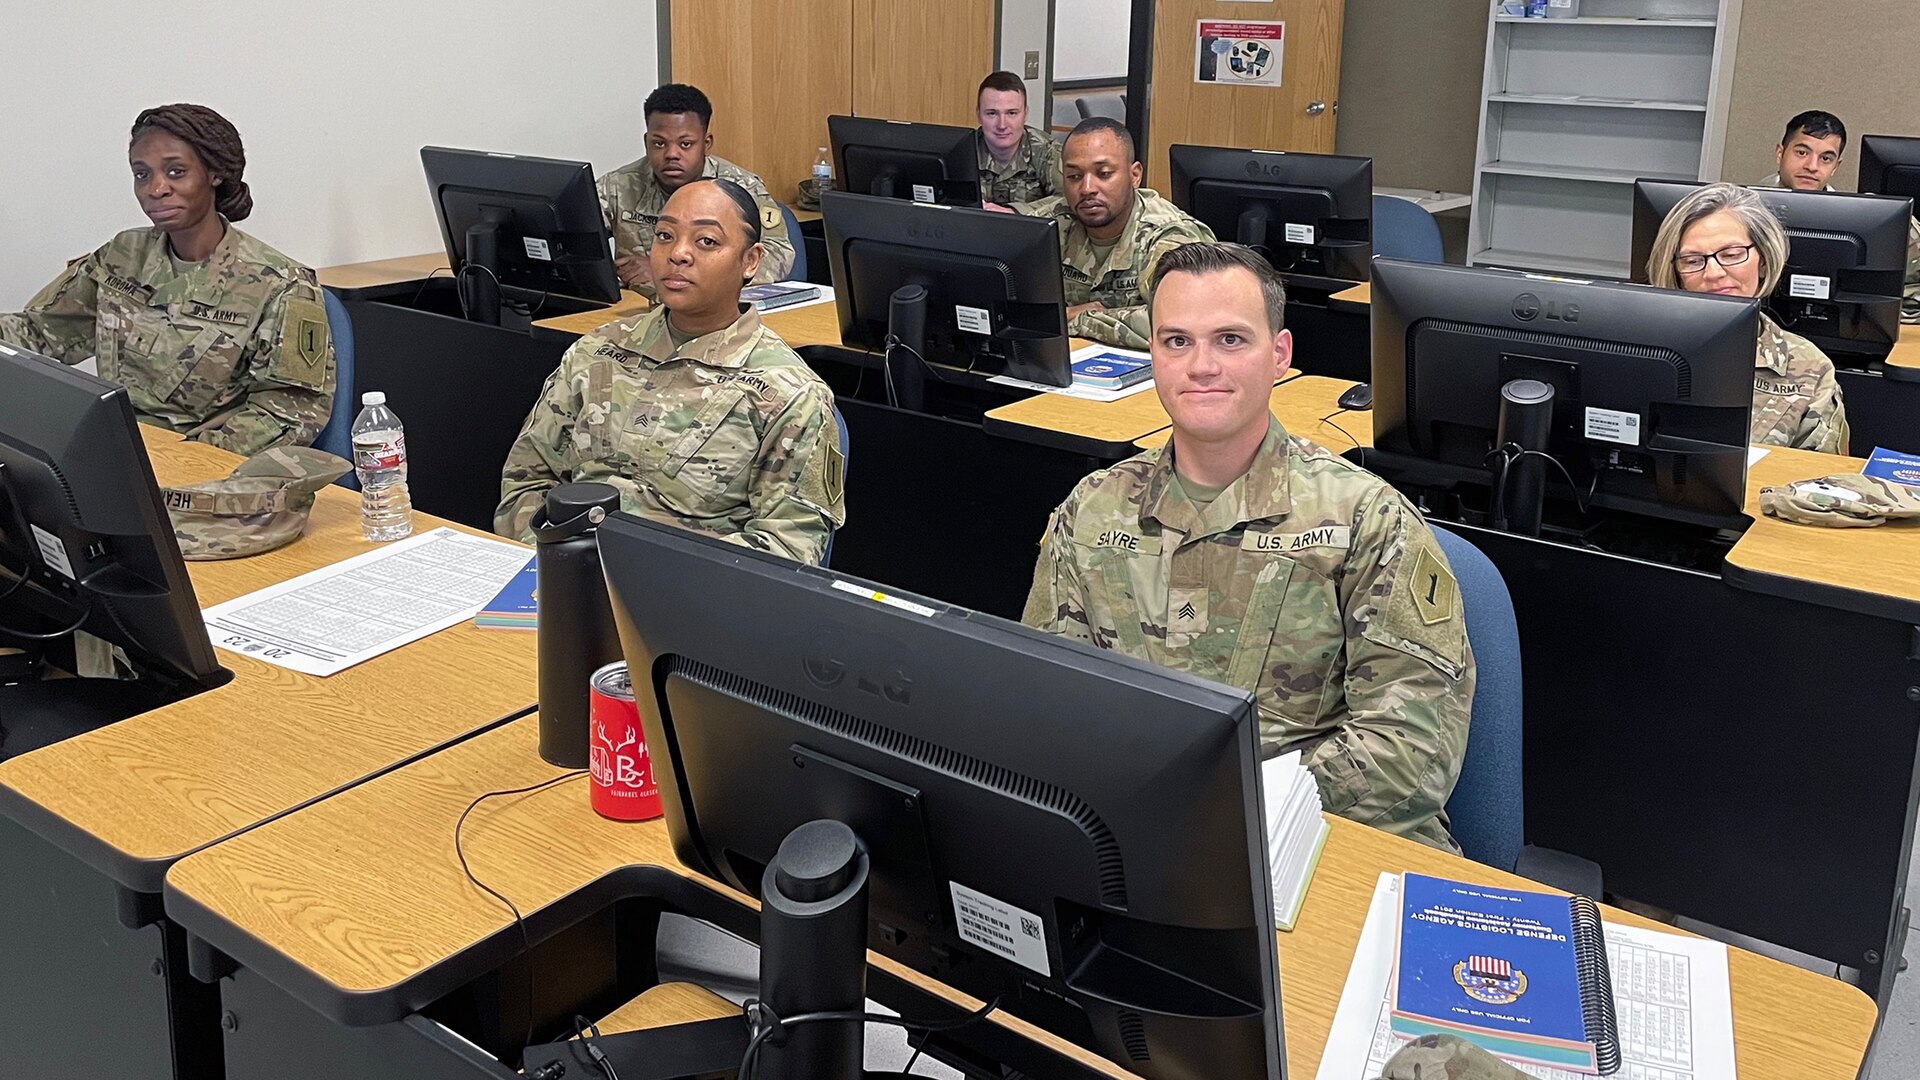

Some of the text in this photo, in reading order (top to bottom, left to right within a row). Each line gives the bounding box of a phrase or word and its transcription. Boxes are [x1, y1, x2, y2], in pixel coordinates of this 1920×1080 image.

[1263, 164, 1281, 176] LG
[628, 212, 658, 226] JACKSO
[765, 211, 773, 223] 1
[104, 275, 138, 297] KOROMA
[193, 306, 240, 322] U.S. ARMY
[1546, 300, 1580, 323] LG
[307, 329, 314, 352] 1
[594, 346, 628, 364] HEARD
[738, 375, 769, 393] ARMY
[1772, 383, 1803, 394] ARMY
[1097, 530, 1140, 551] SAYRE
[1256, 529, 1335, 550] U.S. ARMY
[1425, 573, 1438, 607] 1
[221, 634, 250, 649] 23
[262, 647, 291, 659] 20
[1423, 908, 1553, 933] Customer Assistance Handbook
[1455, 909, 1484, 918] Edition
[1485, 913, 1504, 921] First
[1512, 916, 1541, 926] Twenty
[1410, 912, 1567, 942] DEFENSE LOGISTICS AGENCY
[1451, 1006, 1469, 1014] ONLY
[1485, 1012, 1515, 1021] OFFICIAL
